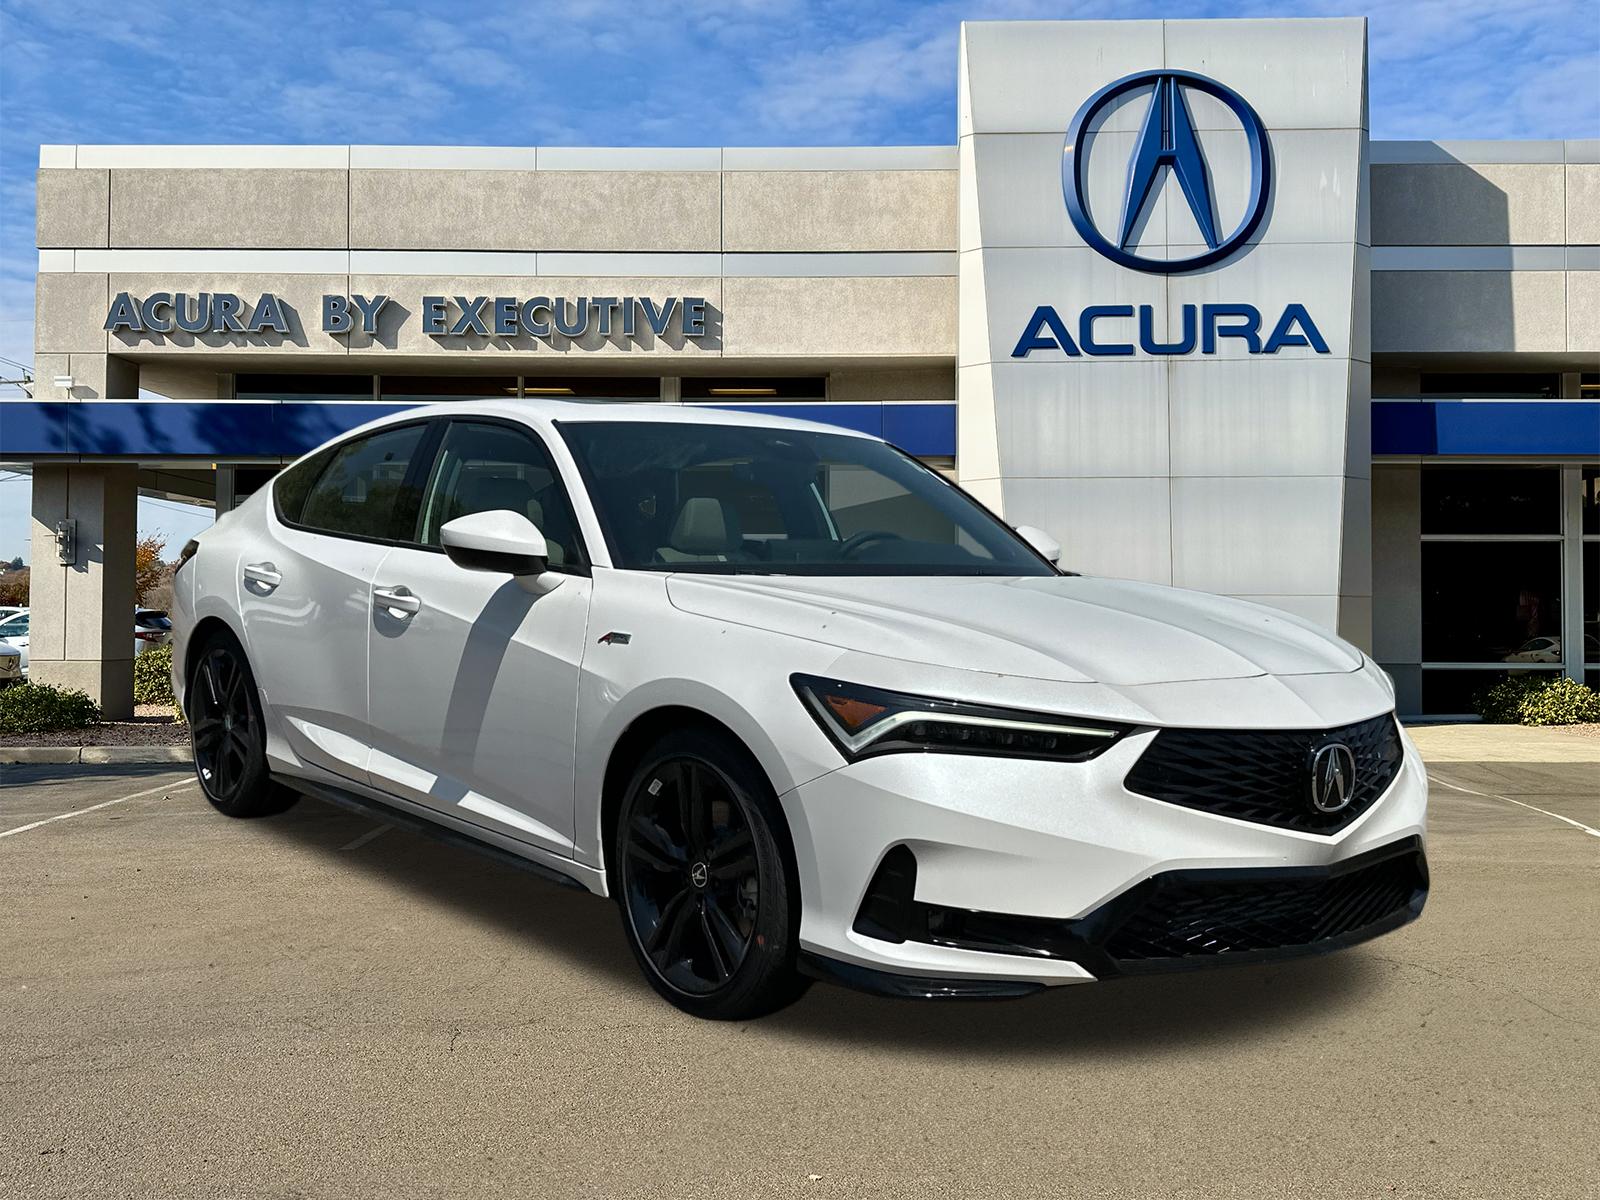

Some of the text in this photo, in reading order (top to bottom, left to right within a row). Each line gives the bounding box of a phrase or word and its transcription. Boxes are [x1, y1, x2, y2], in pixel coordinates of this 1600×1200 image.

[104, 291, 707, 338] ACURA BY EXECUTIVE
[1011, 303, 1332, 358] ACURA
